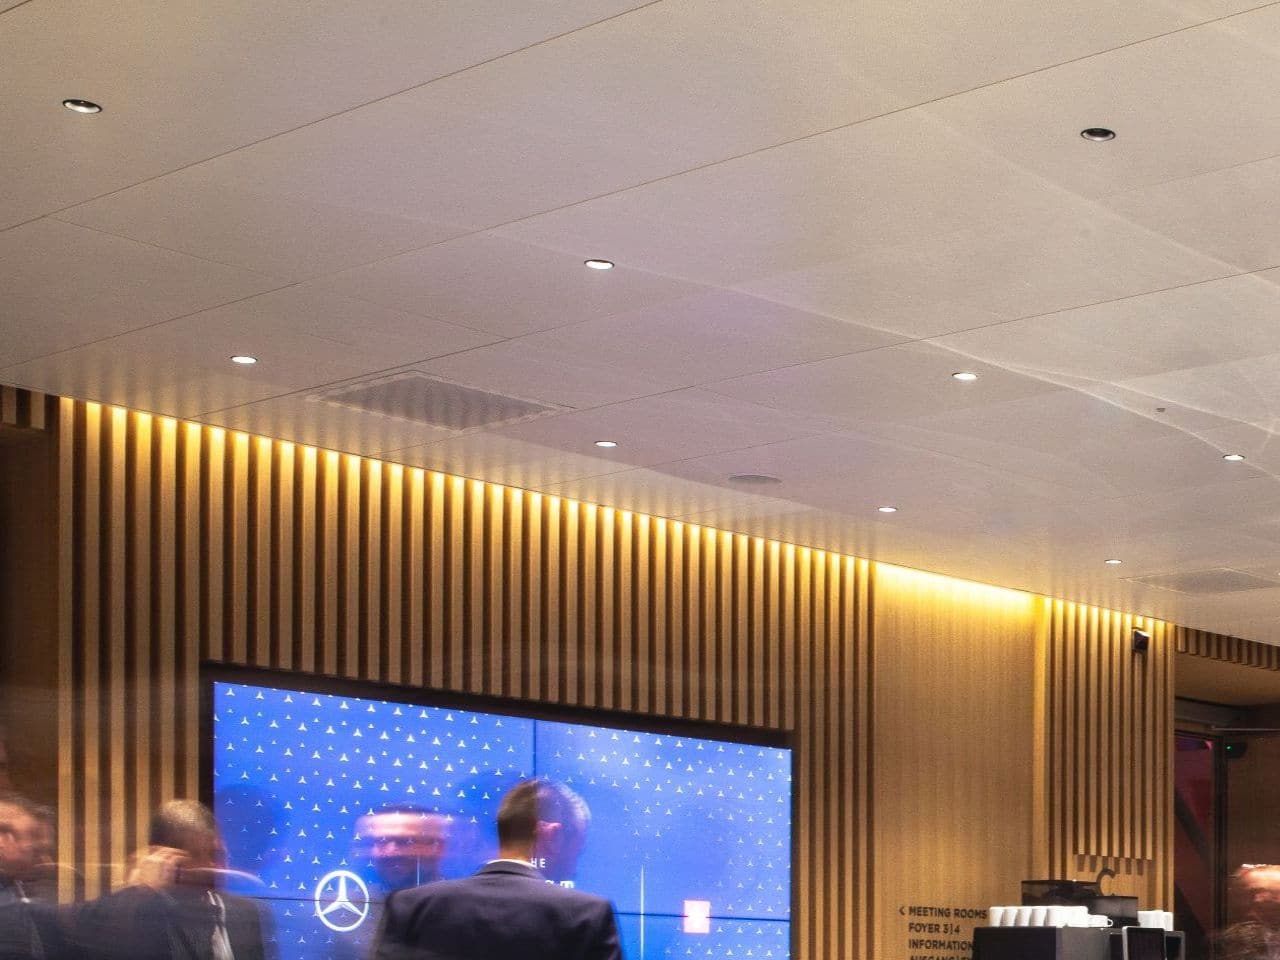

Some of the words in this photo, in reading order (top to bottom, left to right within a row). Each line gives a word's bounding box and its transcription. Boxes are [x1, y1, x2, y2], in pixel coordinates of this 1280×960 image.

[908, 906, 950, 918] MEETING
[954, 909, 988, 920] ROOMS
[908, 923, 940, 934] FOYER
